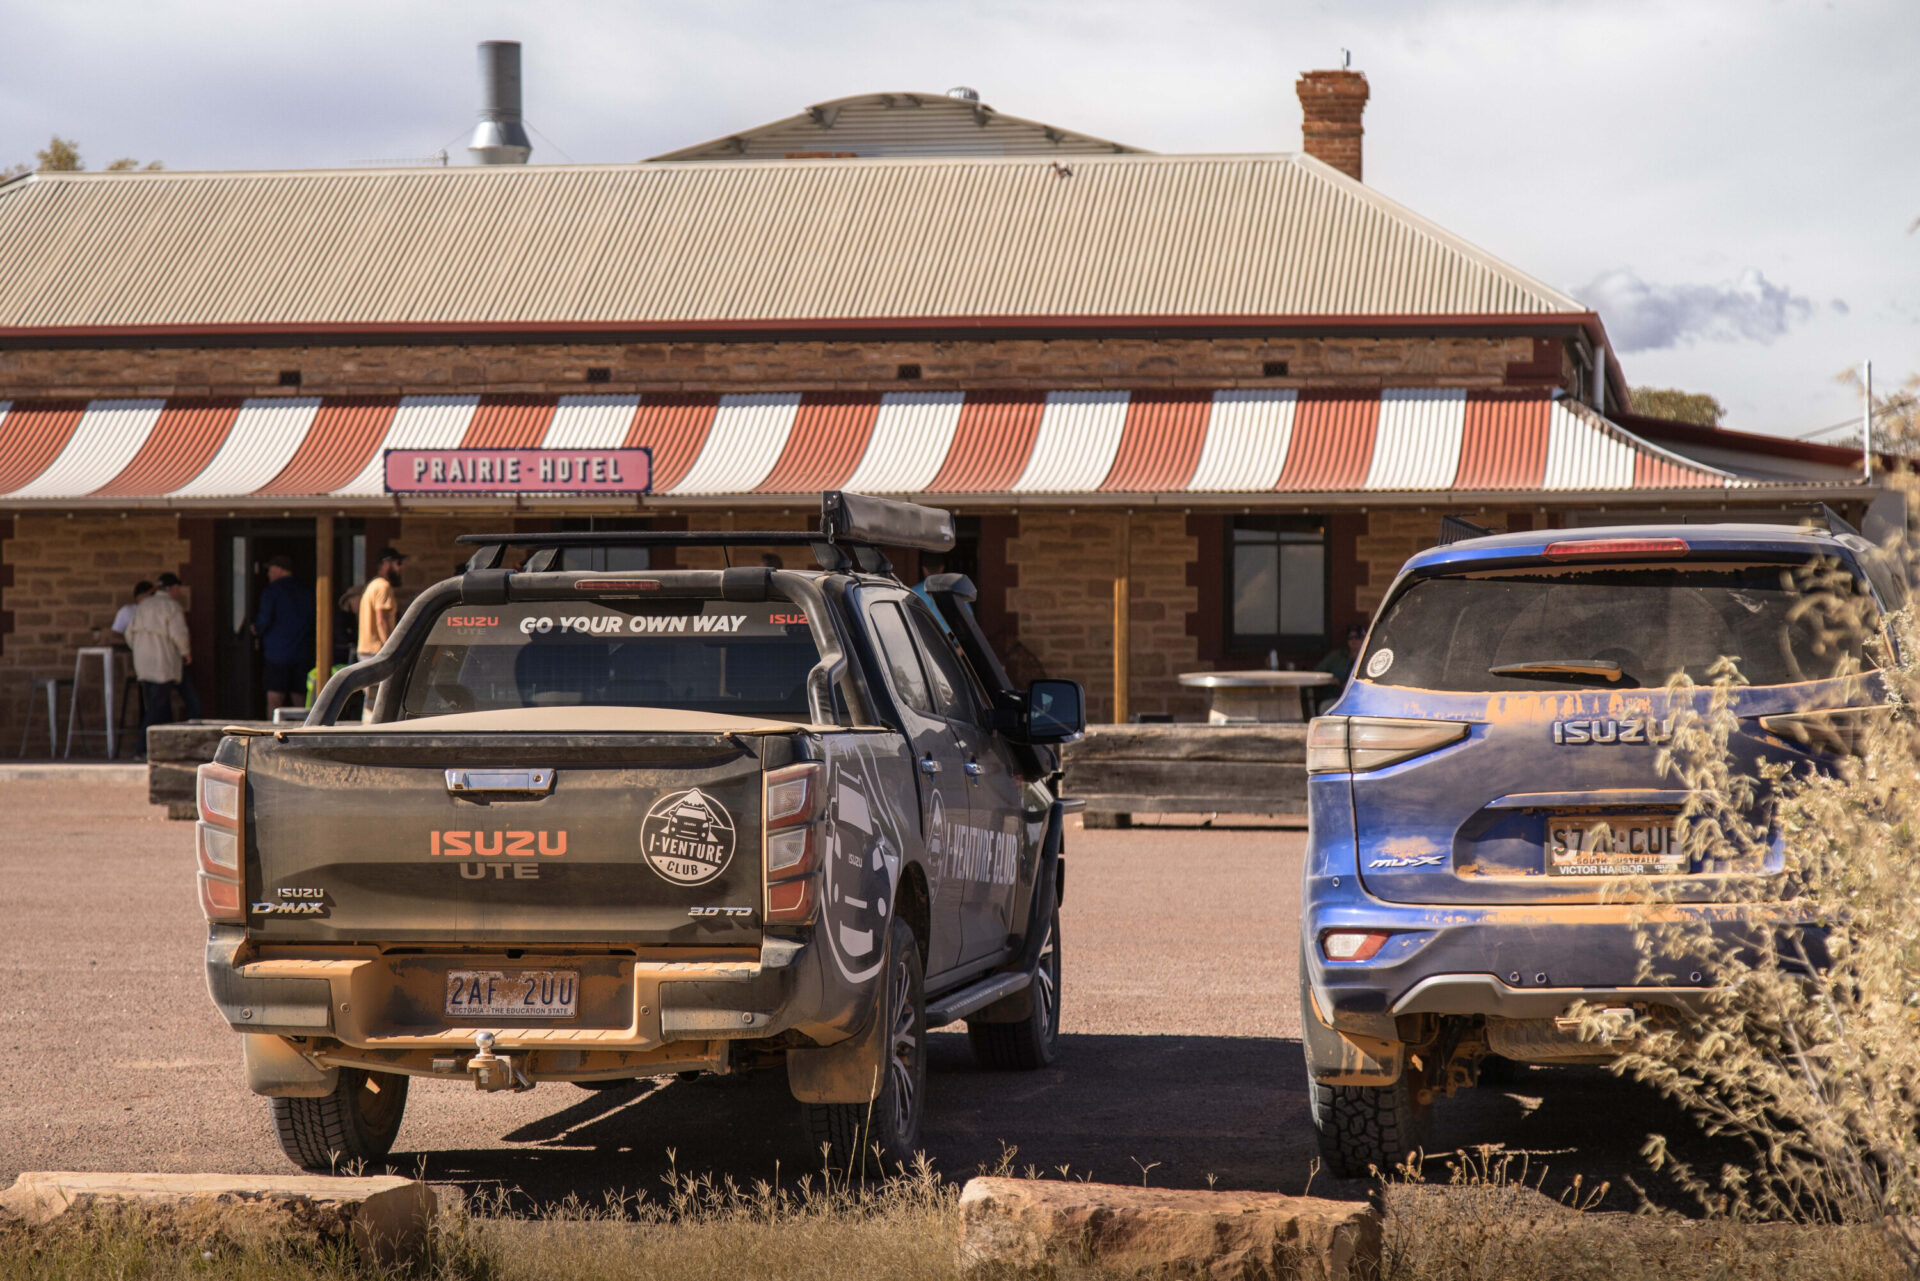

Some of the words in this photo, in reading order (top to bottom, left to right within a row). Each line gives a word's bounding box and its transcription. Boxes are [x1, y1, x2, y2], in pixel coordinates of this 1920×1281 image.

[447, 616, 499, 627] ISUZU
[519, 616, 553, 634] GO
[560, 616, 623, 634] YOUR
[629, 615, 687, 633] OWN
[693, 615, 747, 633] WAY
[769, 614, 809, 625] ISUZ
[457, 628, 487, 636] UTE
[1553, 719, 1673, 744] ISUZU
[430, 831, 567, 856] ISUZU
[649, 833, 724, 864] I-VENTURE
[1576, 857, 1607, 865] SOUTH
[1613, 856, 1661, 864] USTRALIA
[460, 862, 540, 879] UTE
[666, 860, 699, 876] CLUB
[1559, 865, 1597, 875] VICTOR
[277, 888, 324, 898] ISUZU
[251, 902, 324, 914] D-MAX
[451, 977, 500, 1005] 2AF
[523, 977, 573, 1006] 2UU
[452, 1007, 484, 1015] VICTORIA
[491, 1007, 504, 1015] THE
[506, 1007, 546, 1015] EDUCATION
[547, 1007, 569, 1015] STATE
